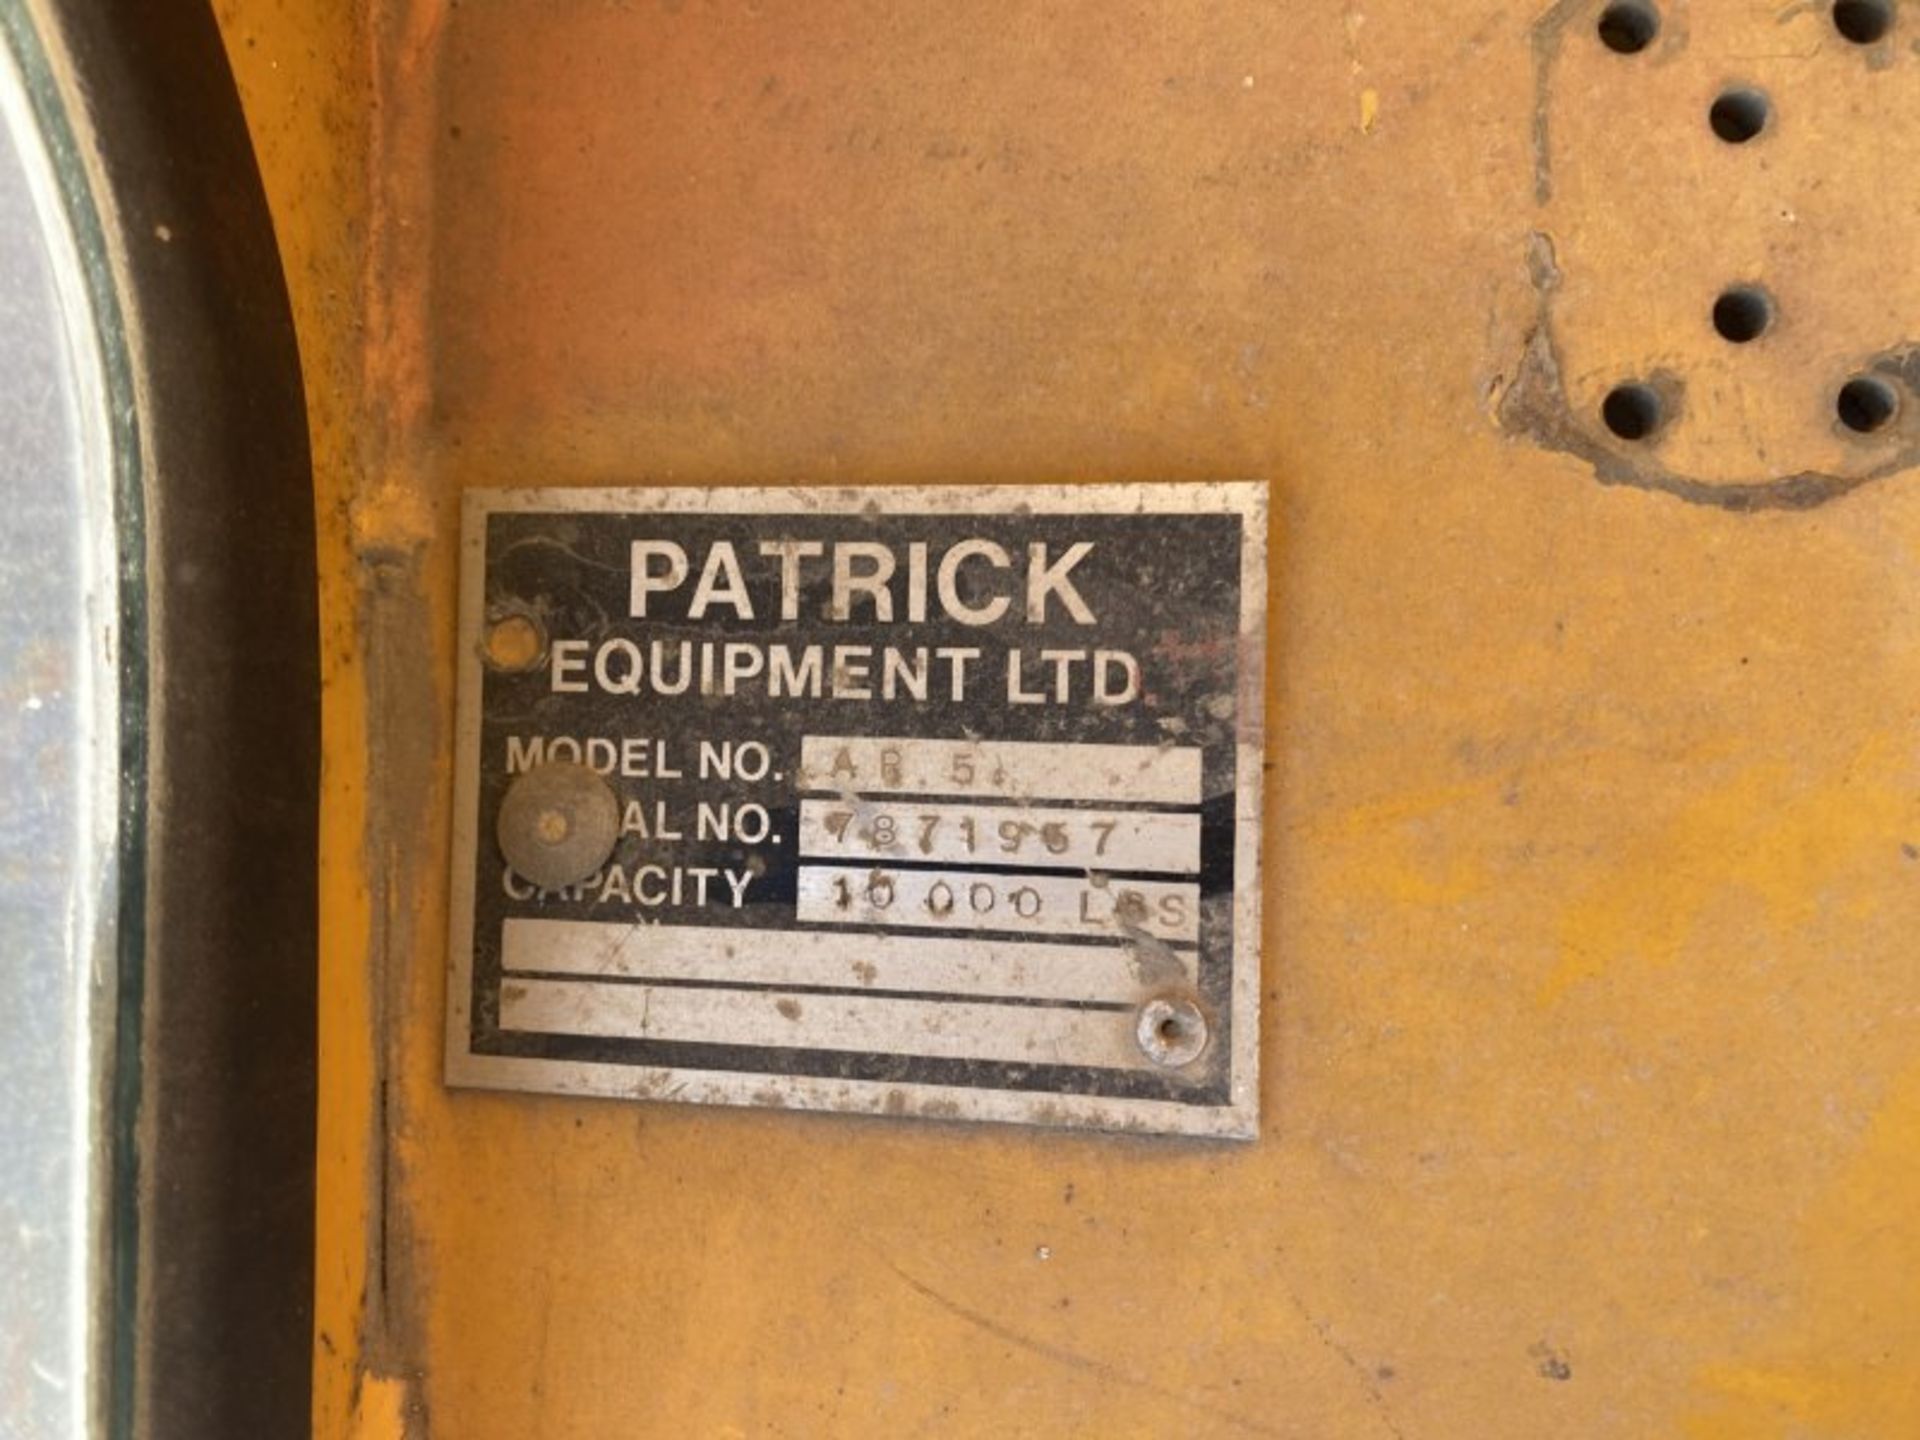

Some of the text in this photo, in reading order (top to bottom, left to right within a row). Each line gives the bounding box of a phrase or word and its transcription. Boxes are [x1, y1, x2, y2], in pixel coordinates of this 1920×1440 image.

[628, 539, 1096, 626] PATRICK
[550, 640, 981, 702] EQUIPMENT
[700, 741, 784, 781] NO.
[698, 803, 782, 844] NO.
